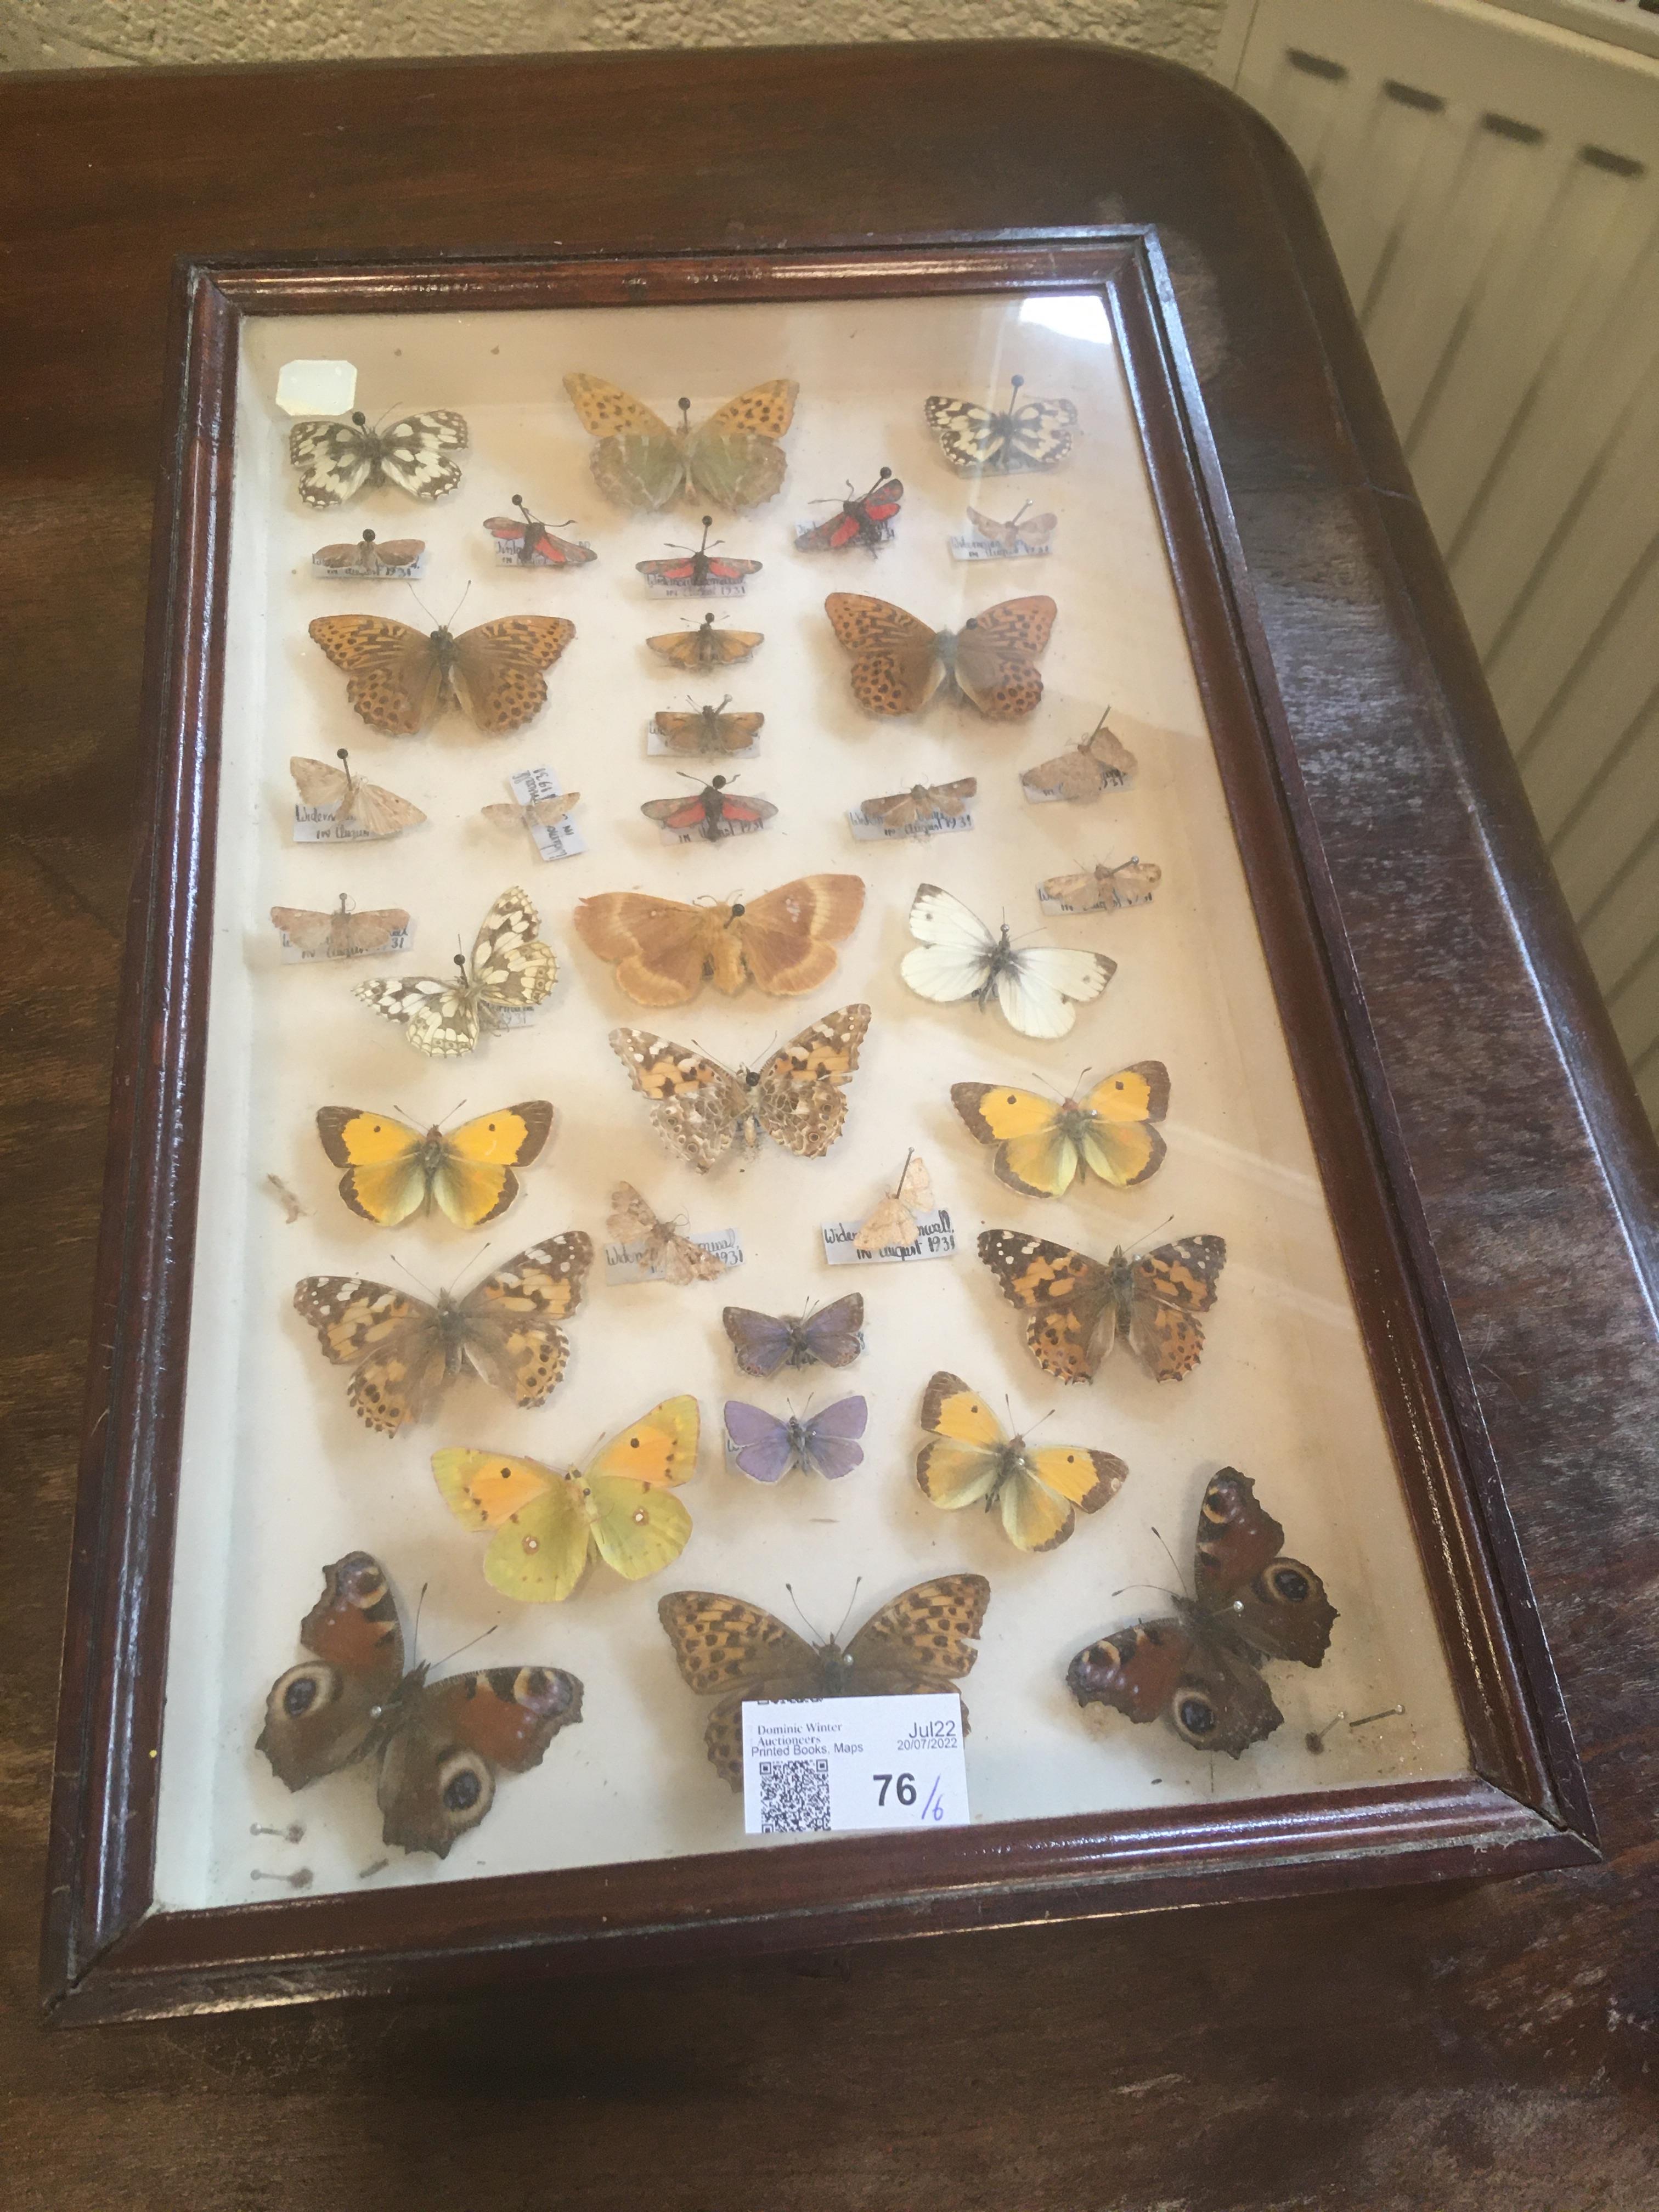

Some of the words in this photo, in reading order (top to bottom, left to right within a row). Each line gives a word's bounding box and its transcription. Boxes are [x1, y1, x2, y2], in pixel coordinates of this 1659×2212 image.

[928, 1235, 955, 1252] 1931
[758, 1723, 803, 1735] Dominic
[806, 1722, 842, 1733] Winter
[909, 1720, 956, 1738] Jul22
[757, 1735, 821, 1747] Auctioneers
[897, 1737, 957, 1751] 20/07/2022
[752, 1745, 789, 1757] Printed
[793, 1743, 830, 1756] Books,
[834, 1742, 864, 1754] Maps
[873, 1773, 917, 1806] 76
